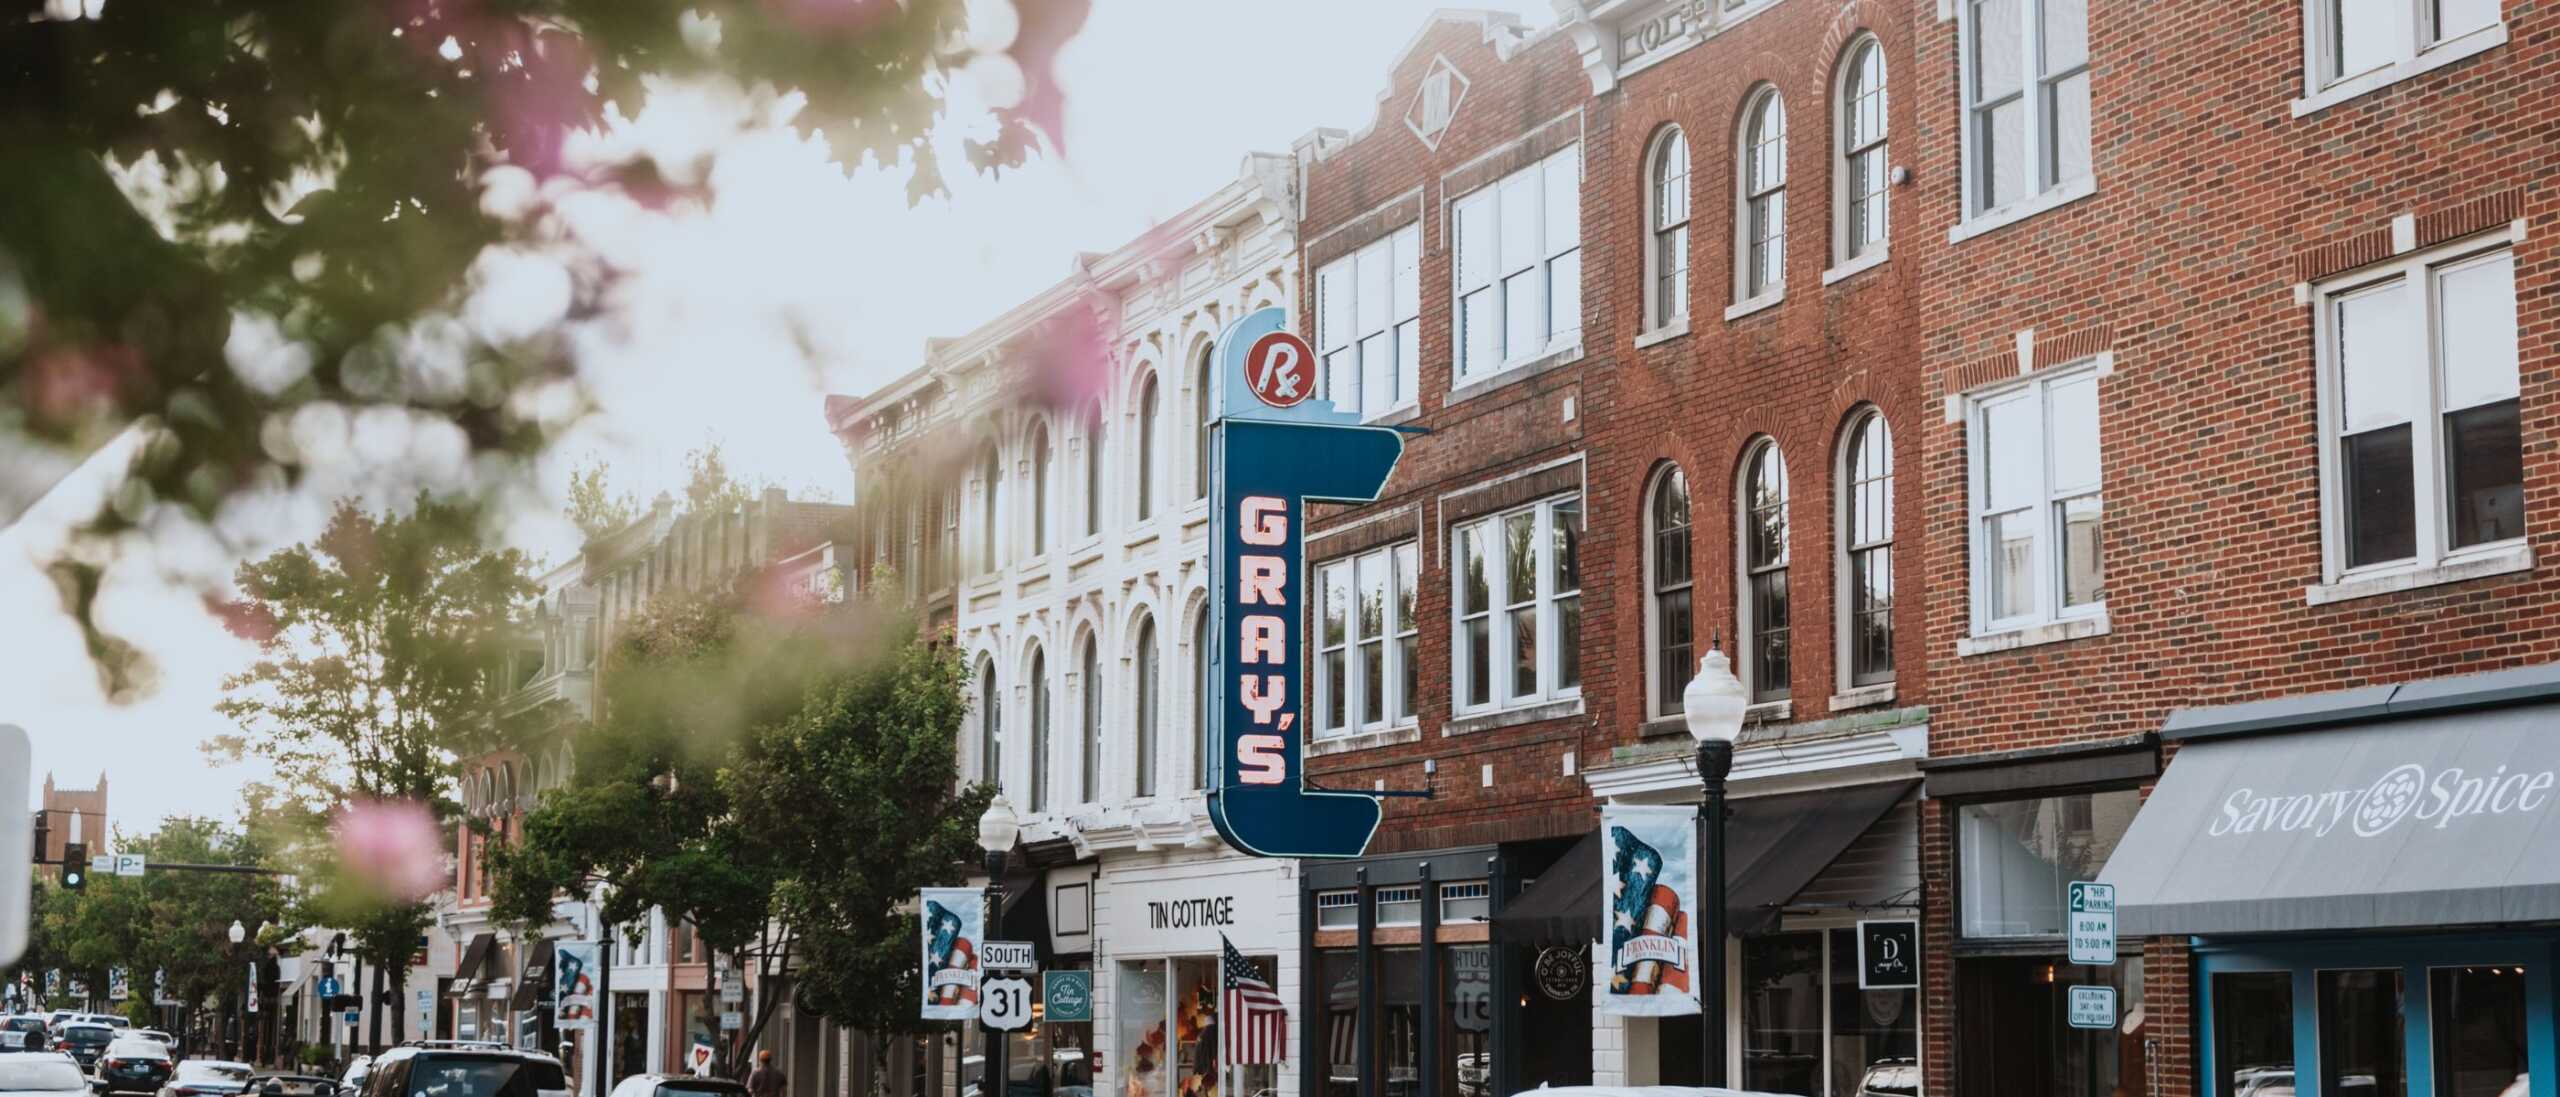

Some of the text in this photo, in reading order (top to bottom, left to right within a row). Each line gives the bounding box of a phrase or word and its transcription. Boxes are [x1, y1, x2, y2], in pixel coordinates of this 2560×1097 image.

[1237, 496, 1296, 785] GRAY'S
[2208, 764, 2555, 838] Savory Spice
[2071, 887, 2083, 909] 2
[2085, 900, 2113, 911] PARKING
[1148, 896, 1234, 929] TIN COTTAGE
[2079, 920, 2107, 932] 8:00 AM
[1626, 939, 1676, 957] FRANKLIN
[2075, 938, 2111, 950] TO 5:00 PM
[984, 946, 1031, 964] SOUTH
[1554, 950, 1582, 976] JOYFUL
[1060, 984, 1075, 996] Tin
[991, 987, 1021, 1018] 31
[1052, 992, 1083, 1007] Cottage
[2073, 1012, 2085, 1021] CITY
